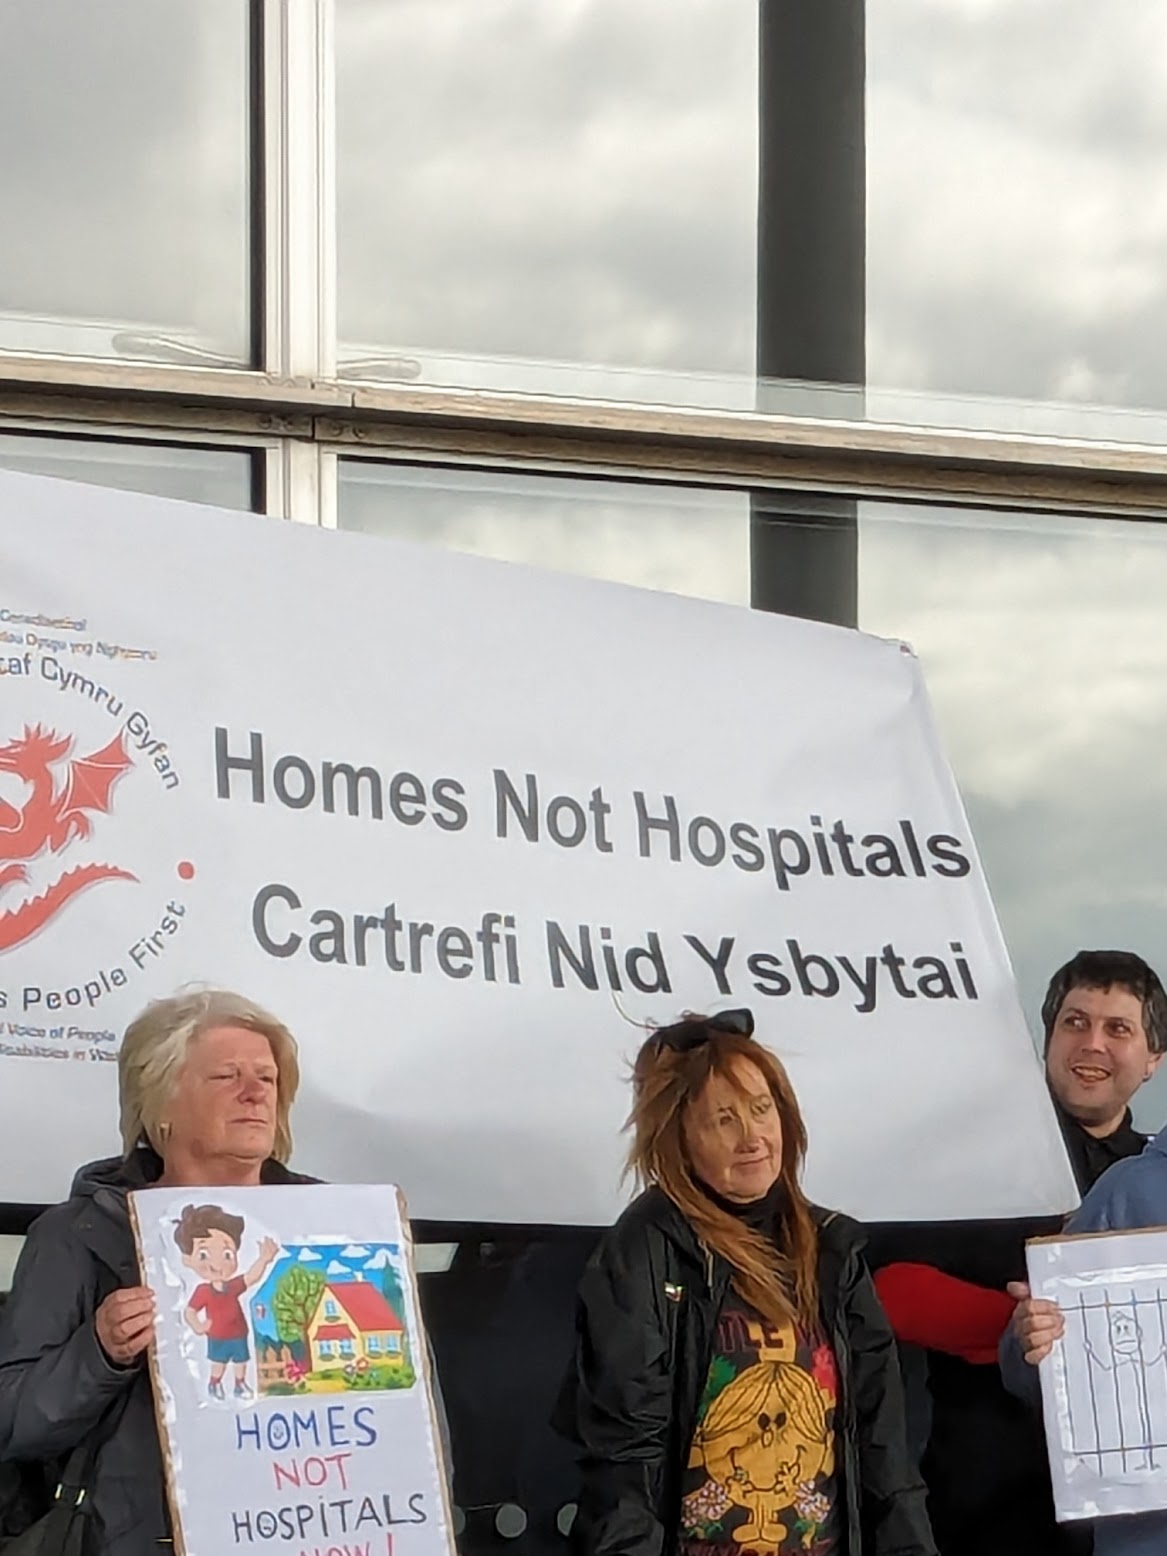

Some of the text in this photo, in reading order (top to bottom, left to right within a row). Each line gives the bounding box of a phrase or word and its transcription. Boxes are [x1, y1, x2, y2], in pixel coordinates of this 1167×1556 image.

[41, 657, 123, 714] Cymru
[127, 711, 179, 790] Gyfan
[214, 727, 972, 891] Homes Not Hospitals
[23, 968, 128, 1012] People
[129, 899, 186, 971] First
[251, 883, 979, 1013] Cartrefi Nid Ysbytai
[236, 1406, 378, 1452] HOMES
[274, 1453, 352, 1491] NOT
[232, 1494, 429, 1545] HOSPITALS
